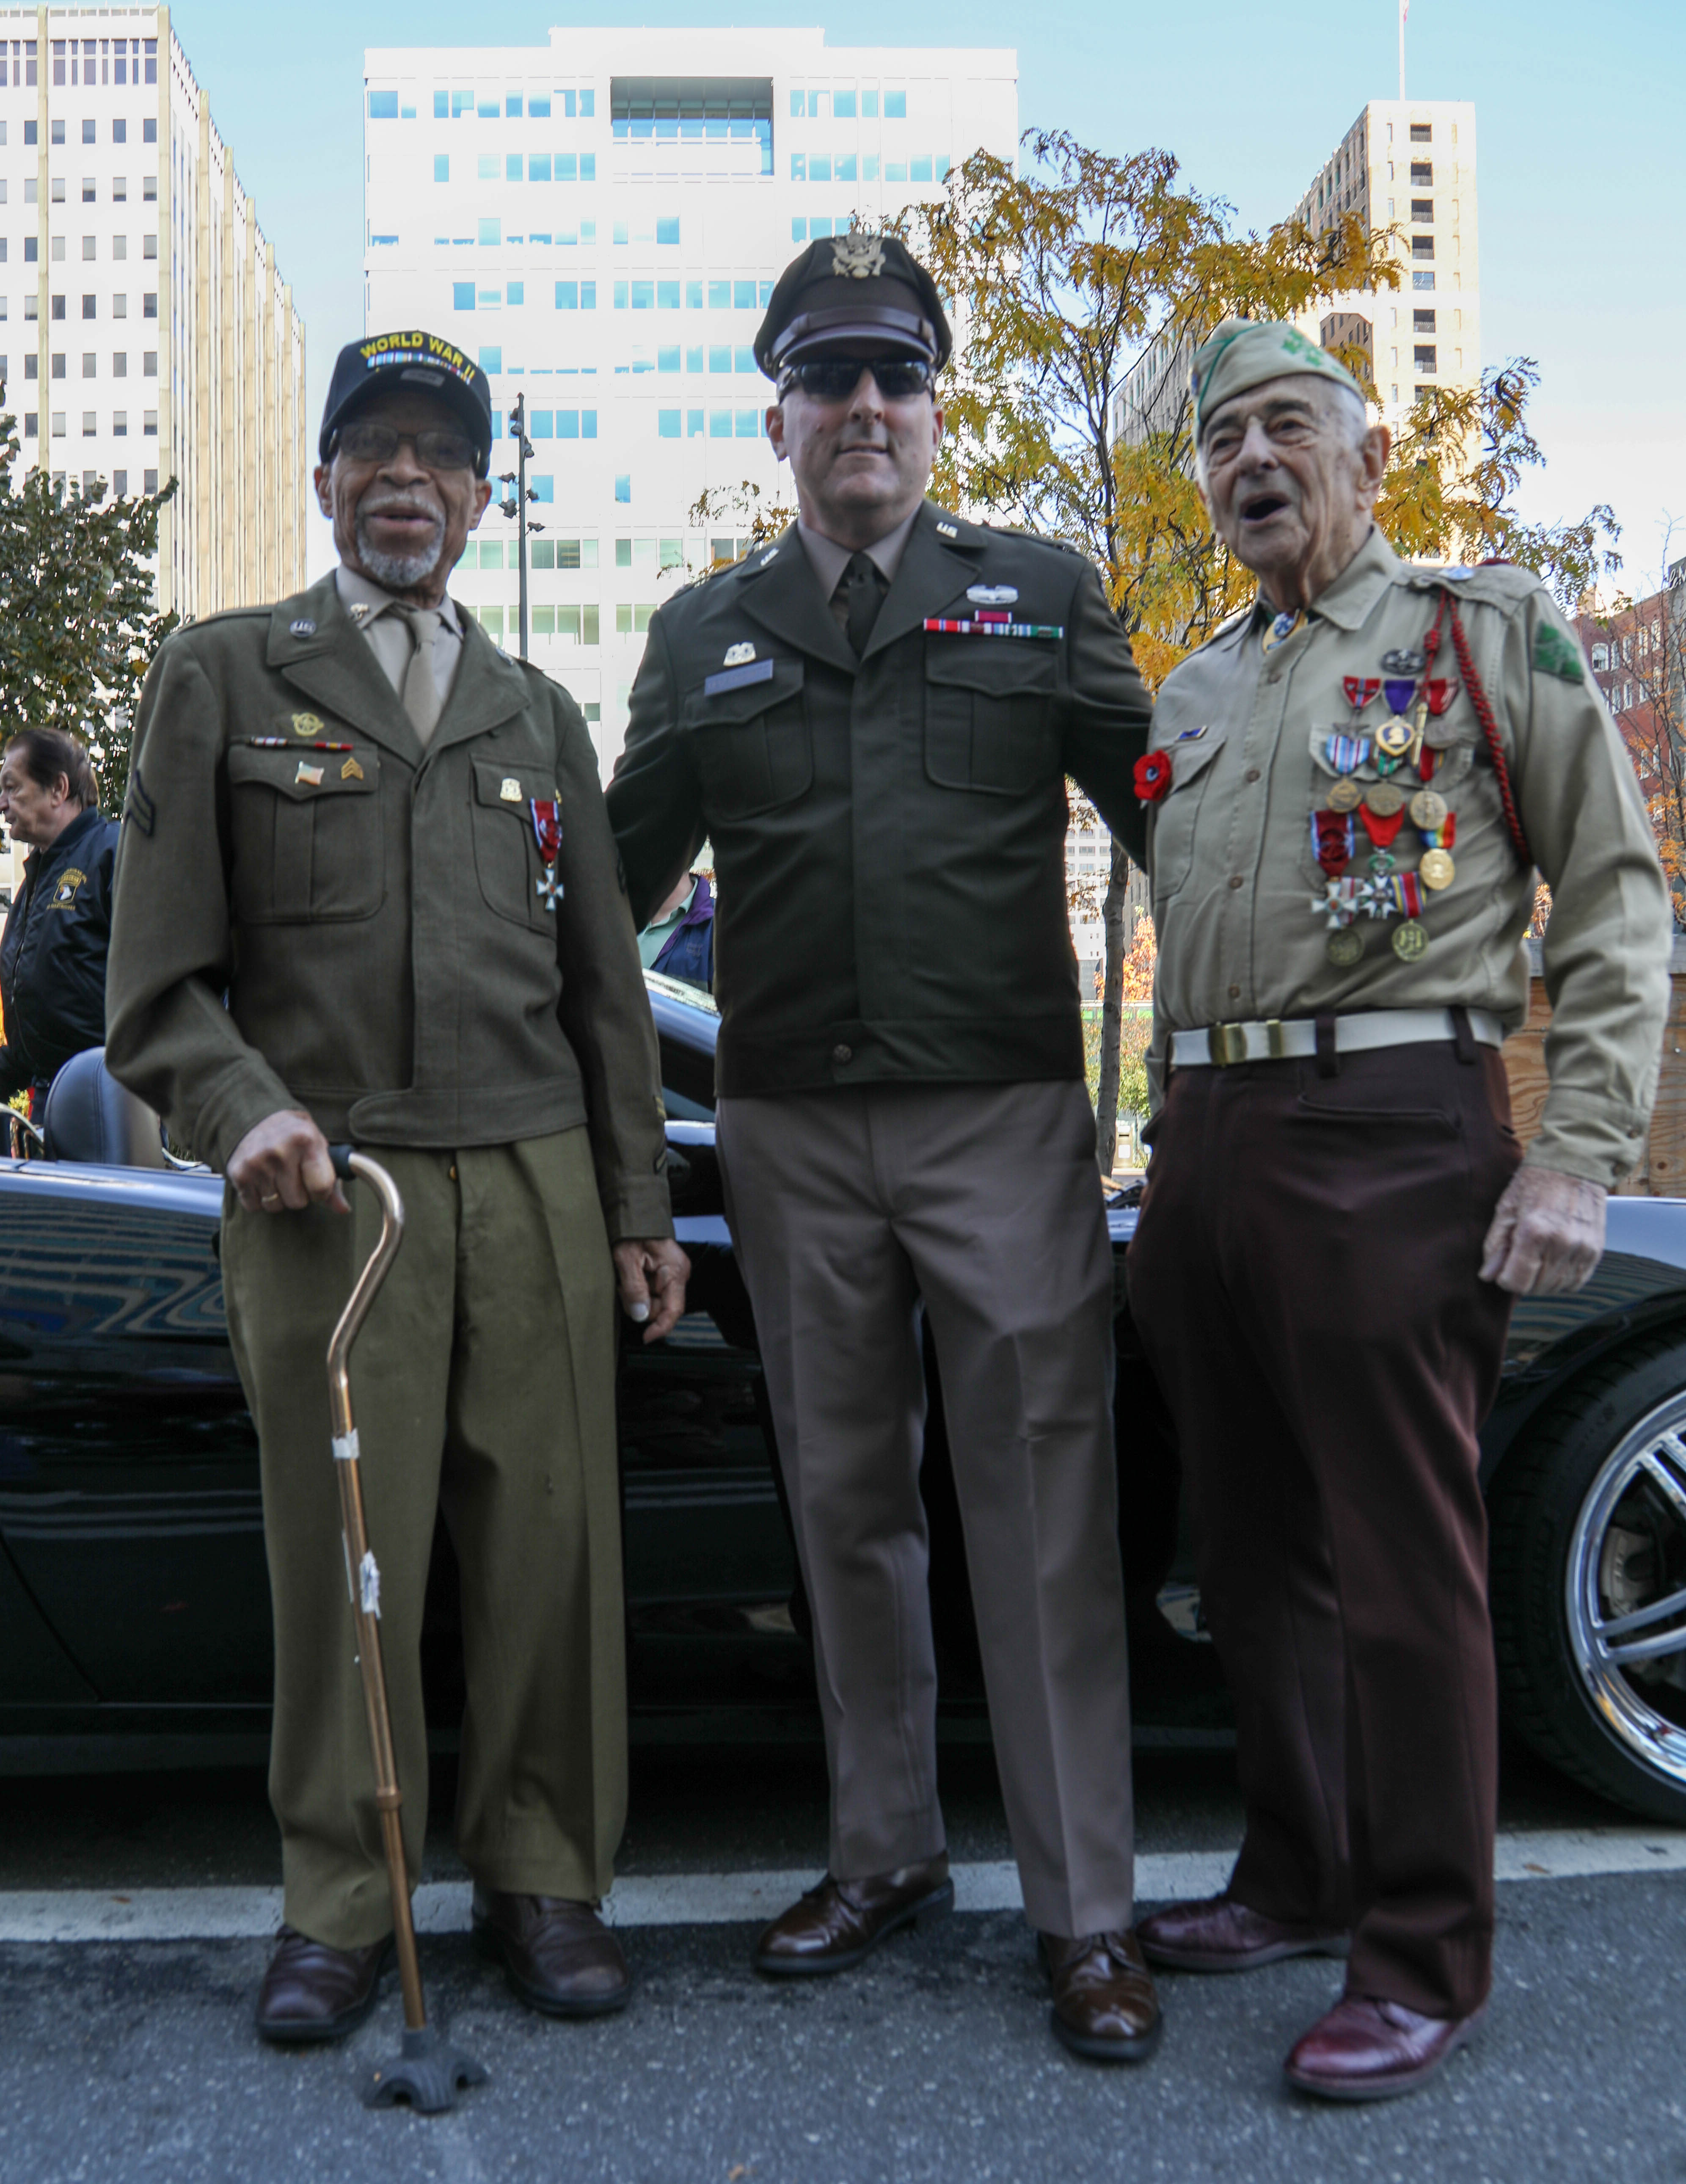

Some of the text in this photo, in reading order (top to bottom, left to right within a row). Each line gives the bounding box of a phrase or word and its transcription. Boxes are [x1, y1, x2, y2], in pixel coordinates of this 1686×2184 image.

[360, 332, 423, 359] WORLD
[429, 336, 463, 368] WAR
[464, 364, 476, 380] II
